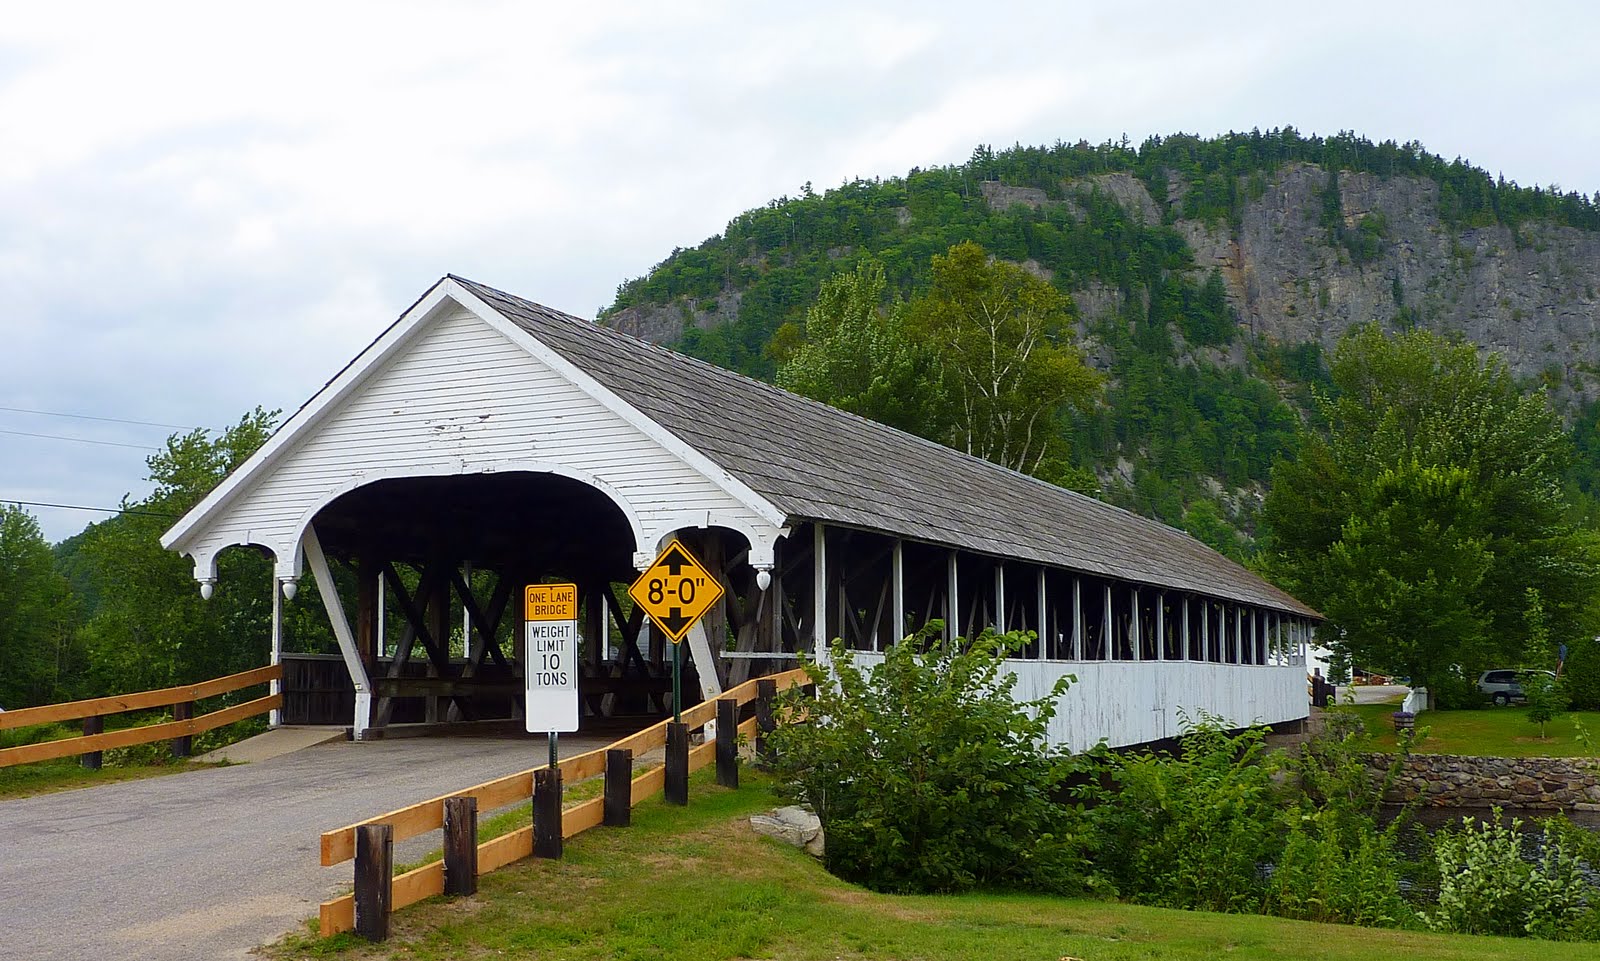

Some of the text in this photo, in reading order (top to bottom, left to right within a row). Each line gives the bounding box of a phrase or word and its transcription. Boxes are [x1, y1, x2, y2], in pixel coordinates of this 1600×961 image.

[648, 578, 704, 604] 8'-0"
[529, 592, 572, 603] ONE LANE
[535, 604, 567, 615] BRIDGE
[533, 626, 570, 638] WEIGHT
[537, 640, 565, 652] LIMIT
[542, 654, 560, 670] 10
[536, 672, 567, 685] TONS
